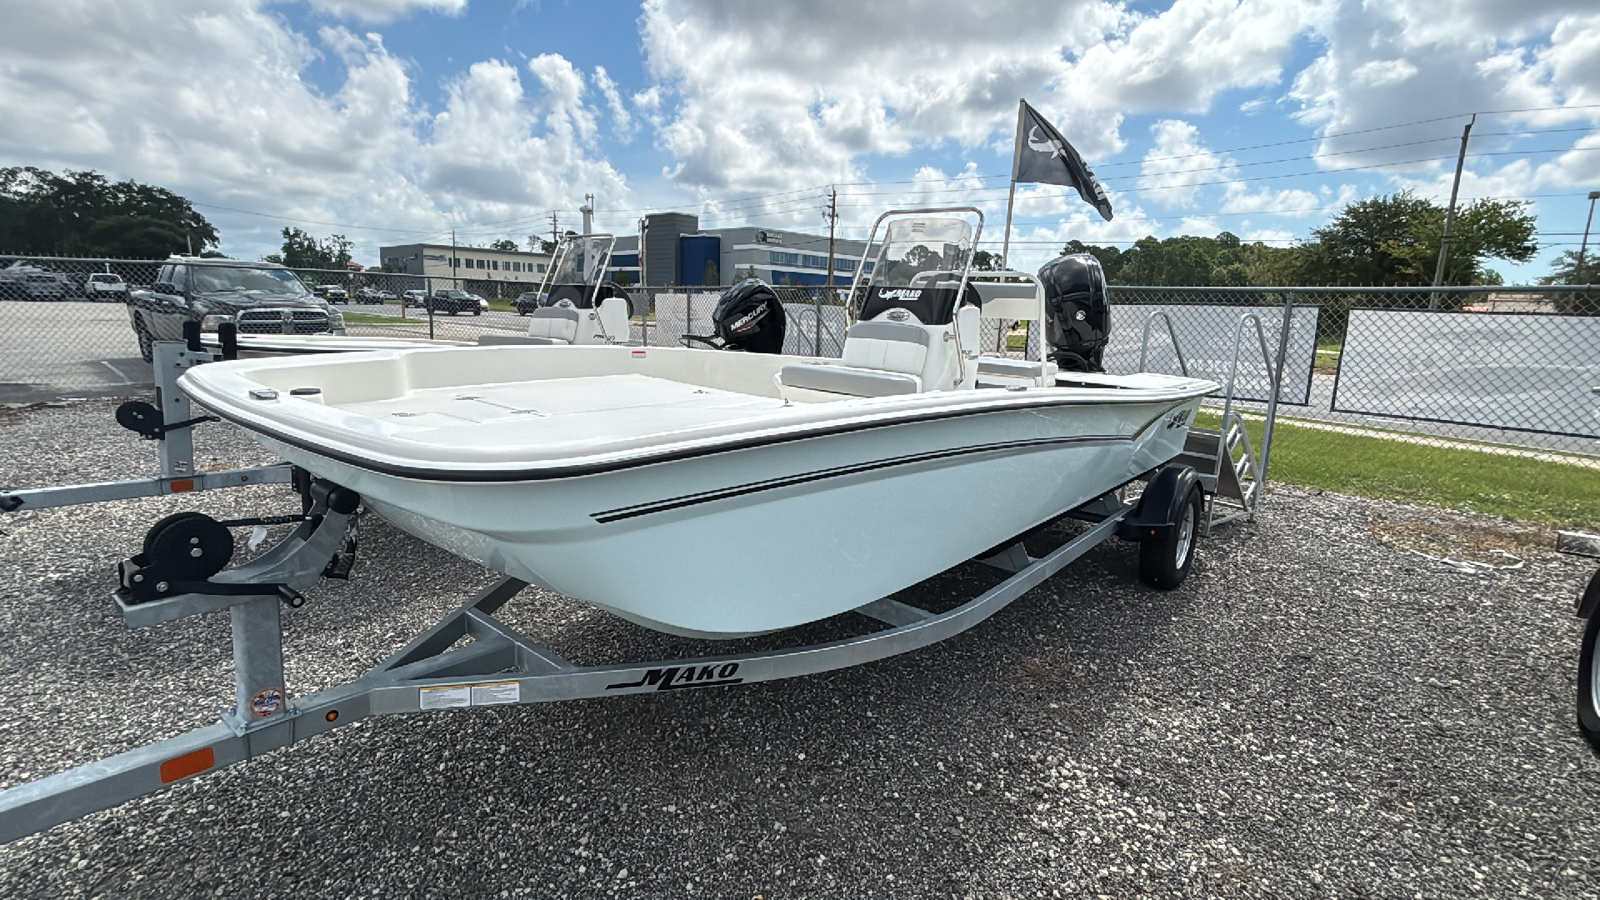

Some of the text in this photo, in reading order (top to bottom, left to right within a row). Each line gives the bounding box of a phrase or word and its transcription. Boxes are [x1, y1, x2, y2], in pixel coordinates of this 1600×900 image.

[894, 289, 922, 301] MAKO
[730, 301, 768, 331] MERCURY
[606, 662, 743, 690] MAKO
